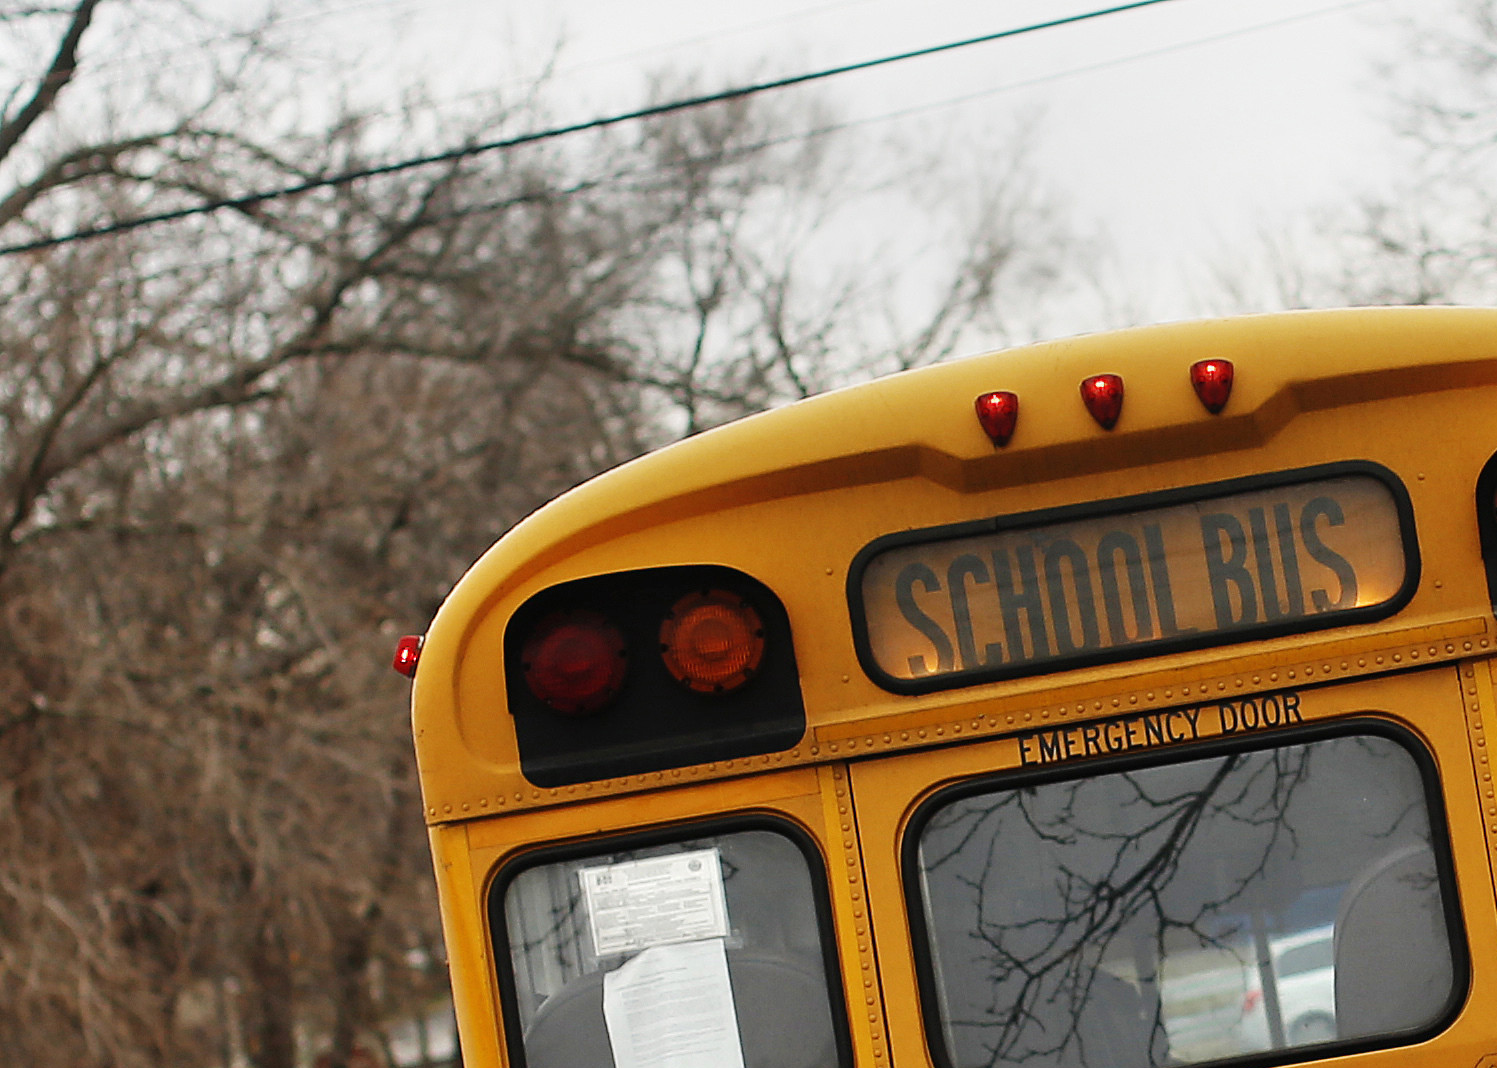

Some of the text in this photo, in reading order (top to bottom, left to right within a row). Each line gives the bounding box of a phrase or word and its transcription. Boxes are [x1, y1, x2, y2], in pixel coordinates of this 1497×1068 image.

[895, 494, 1360, 677] SCHOOL BUS
[1017, 692, 1301, 767] EMERGENCY DOOR
